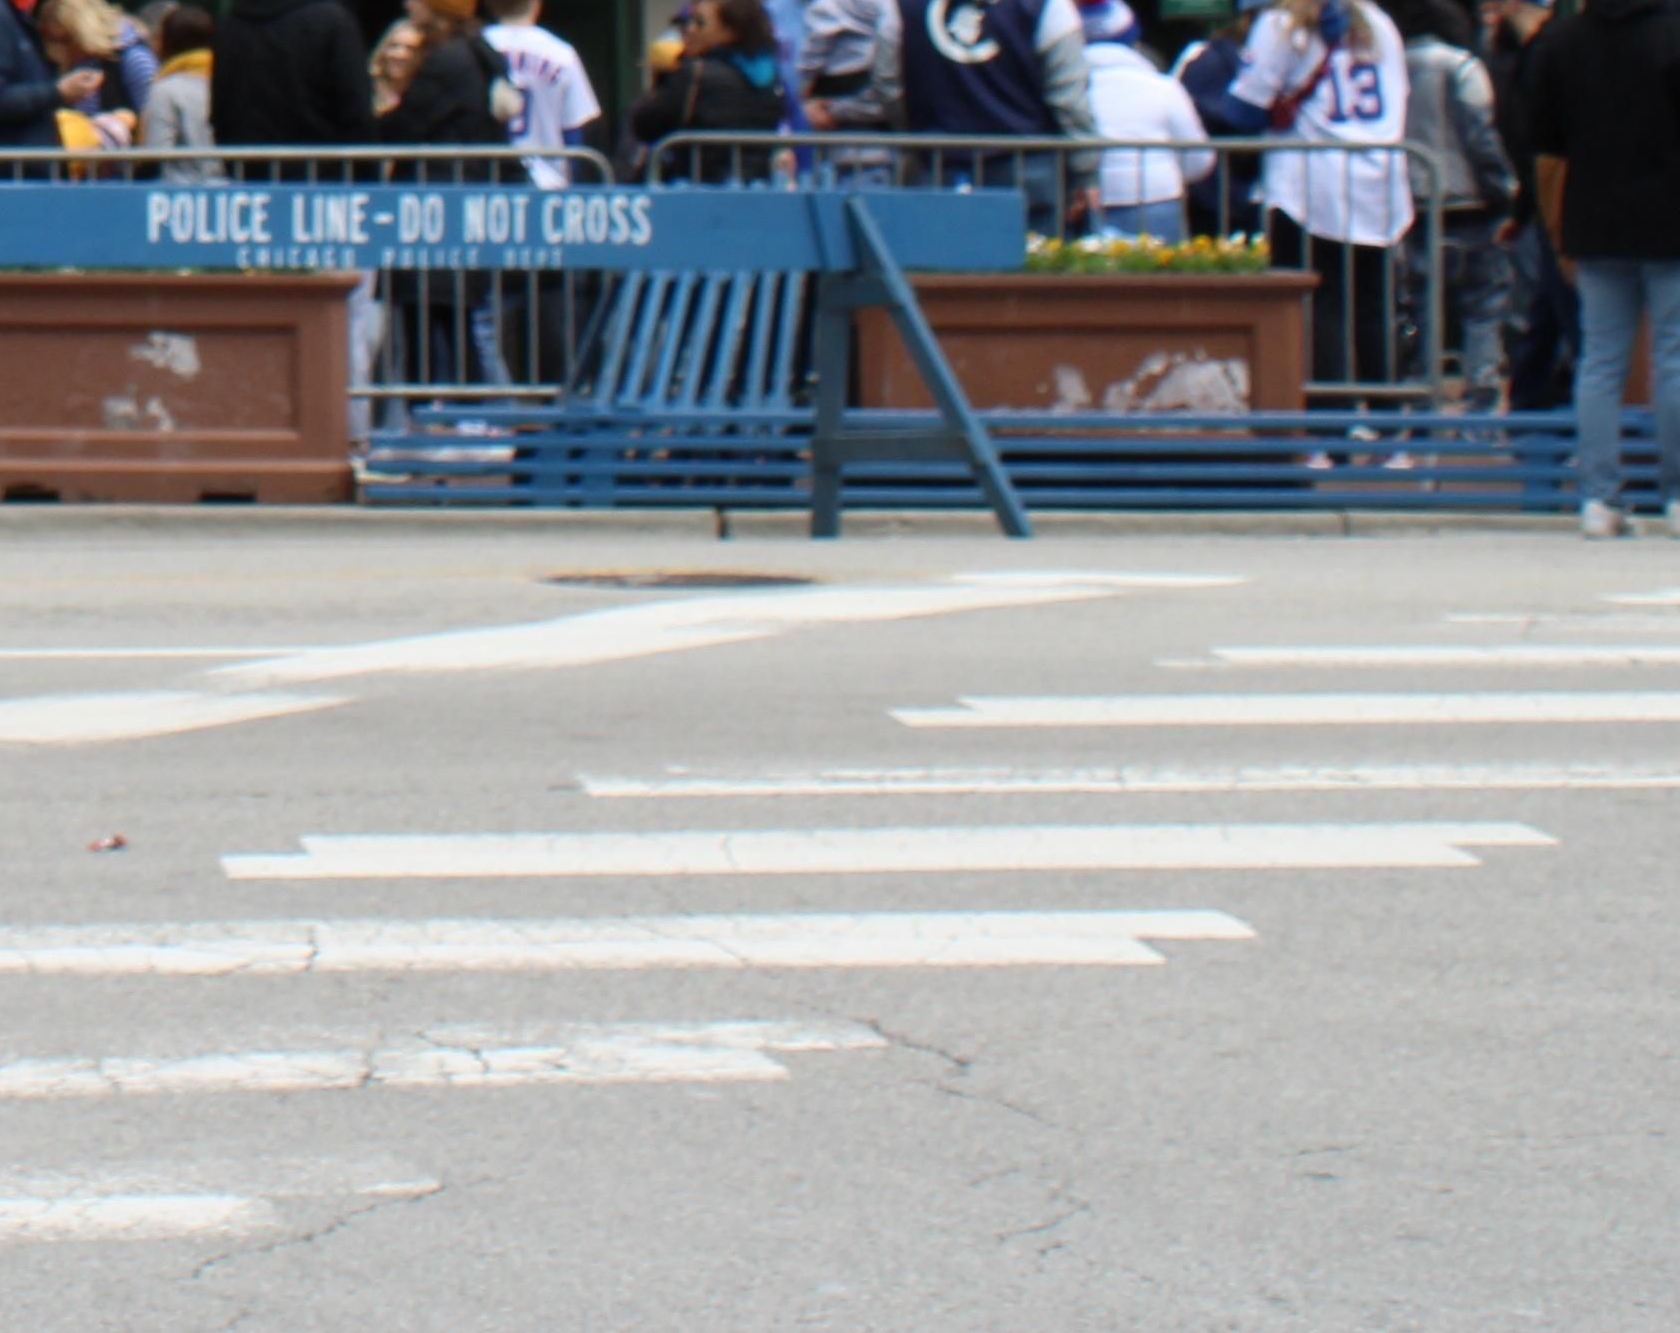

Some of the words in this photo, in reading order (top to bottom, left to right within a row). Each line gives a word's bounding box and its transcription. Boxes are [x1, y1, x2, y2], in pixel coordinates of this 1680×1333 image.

[146, 190, 273, 245] POLICE
[462, 193, 530, 247] NOT
[541, 193, 653, 247] CROSS
